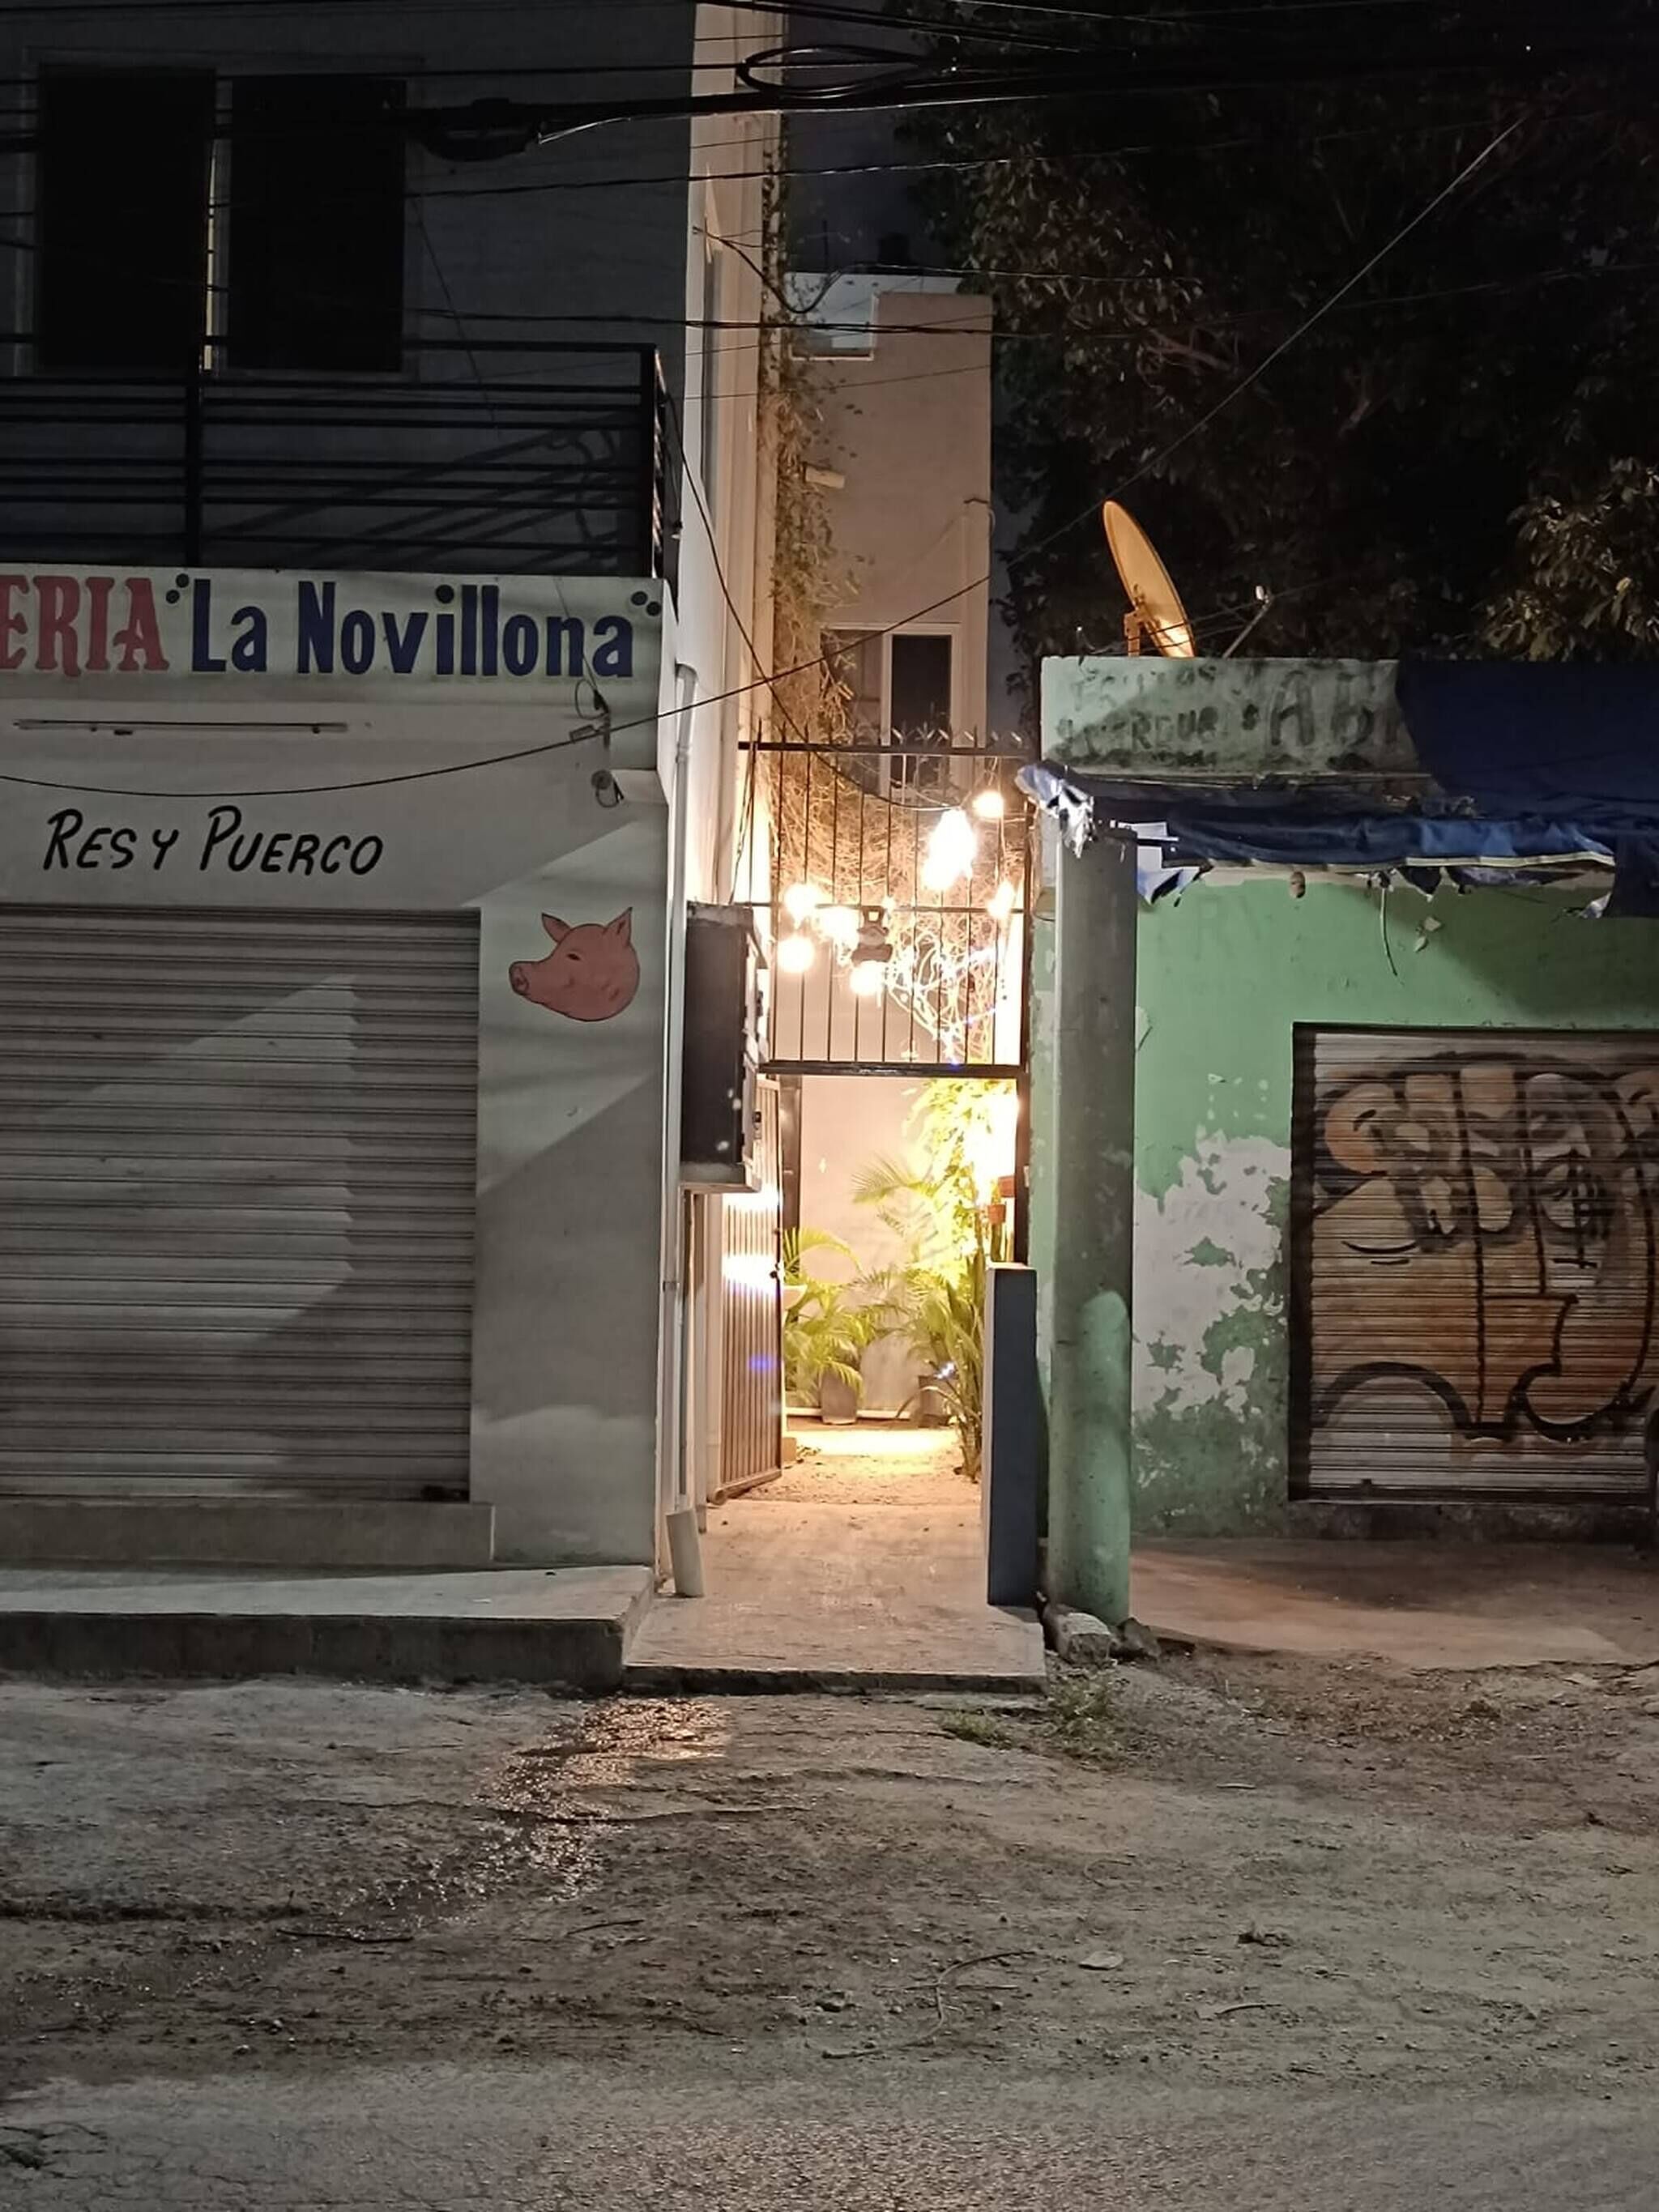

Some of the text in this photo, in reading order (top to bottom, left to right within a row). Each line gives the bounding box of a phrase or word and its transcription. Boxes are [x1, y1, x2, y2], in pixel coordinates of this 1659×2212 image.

[191, 579, 267, 673] La
[297, 582, 634, 678] Novillona
[199, 805, 383, 876] PUERCO
